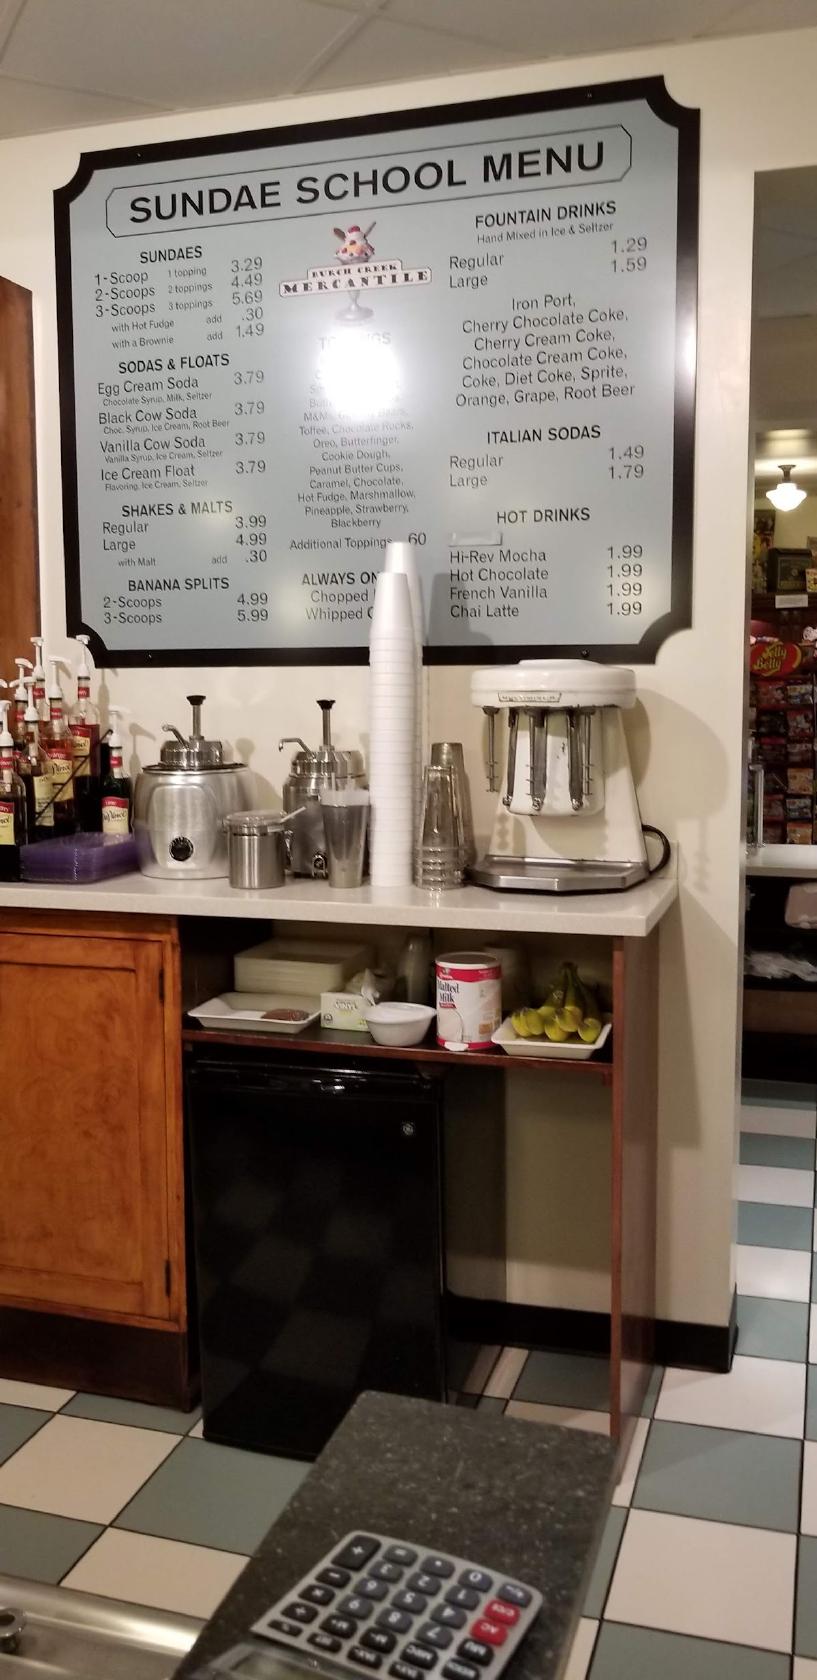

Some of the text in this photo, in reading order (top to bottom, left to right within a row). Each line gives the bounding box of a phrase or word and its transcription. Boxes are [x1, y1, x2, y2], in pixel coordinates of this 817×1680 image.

[129, 140, 605, 223] SUNDAE SCHOOL MENU
[475, 200, 617, 229] FOUNTAIN DRINKS
[477, 221, 614, 244] Hand Mixed in Ice & Seltzer
[140, 245, 203, 264] SUNDAES
[450, 236, 648, 271] Regular 1.29
[175, 267, 207, 279] topping
[231, 257, 263, 272] 3.29
[312, 264, 397, 278] BURCH CREEK
[450, 256, 648, 290] Large 1.59
[95, 273, 263, 301] 2-Scoops toppings 4.49
[283, 270, 428, 294] MERCANTILE
[95, 290, 263, 317] 3-Scoops toppings 5.69
[512, 293, 576, 312] Iron Port,
[112, 307, 264, 333] with Hot Fudge add .30
[462, 307, 629, 334] Cherry Chocolate Coke,
[112, 338, 130, 349] with
[139, 335, 175, 347] Brownie
[207, 331, 223, 342] add
[235, 323, 265, 339] 1.49
[474, 328, 616, 352] Cherry Cream Coke,
[118, 353, 230, 374] SODAS & FLOATS
[462, 346, 628, 371] Chocolate Cream Coke,
[98, 370, 265, 397] Egg Cream Soda 3.79
[462, 365, 628, 390] Coke, Diet Coke, Sprite,
[103, 391, 212, 407] Chocolate Seltzer
[456, 383, 636, 409] Orange, Grape, Root Beer
[99, 401, 265, 425] Black Cow Soda 3.79
[193, 419, 229, 429] Root Beer
[100, 431, 266, 453] Vanilla Cow Soda 3.79
[313, 437, 338, 449] Oreo,
[487, 424, 601, 445] ITALIAN SODAS
[104, 449, 223, 464] Vanilla Seltzer
[321, 448, 391, 461] Cookie Dough,
[450, 444, 645, 471] Regular 1.49
[101, 460, 266, 481] Ice Cream Float 3.79
[309, 462, 404, 477] Peanut Butter Cups,
[450, 464, 645, 489] Large 1.79
[183, 478, 208, 488] Seltzer
[309, 476, 404, 490] Caramel, Chocolate,
[297, 488, 416, 503] Hot Fudge, Marshmallow,
[121, 500, 233, 518] SHAKES & MALTS
[305, 502, 409, 517] Pineapple, Strawberry,
[496, 507, 591, 525] HOT DRINKS
[102, 515, 267, 536] Regular 3.99
[331, 517, 382, 529] Blackberry
[103, 533, 267, 553] Large 4.99
[289, 538, 342, 551] Additional
[118, 550, 267, 567] with Malt add .30
[450, 544, 643, 564] Hi-Rev Mocha 1.99
[302, 571, 356, 586] ALWAYS
[450, 563, 643, 583] Hot Chocolate 1.99
[128, 577, 230, 592] BANANA SPLITS
[450, 582, 643, 601] French Vanilla 1.99
[103, 592, 268, 610] 2-Scoops 4.99
[310, 588, 369, 605] Chopped
[103, 608, 269, 626] 3-Scoops 5.99
[305, 606, 363, 622] Whipped
[450, 600, 643, 619] Chai Latte 1.99
[439, 993, 455, 1003] Milk
